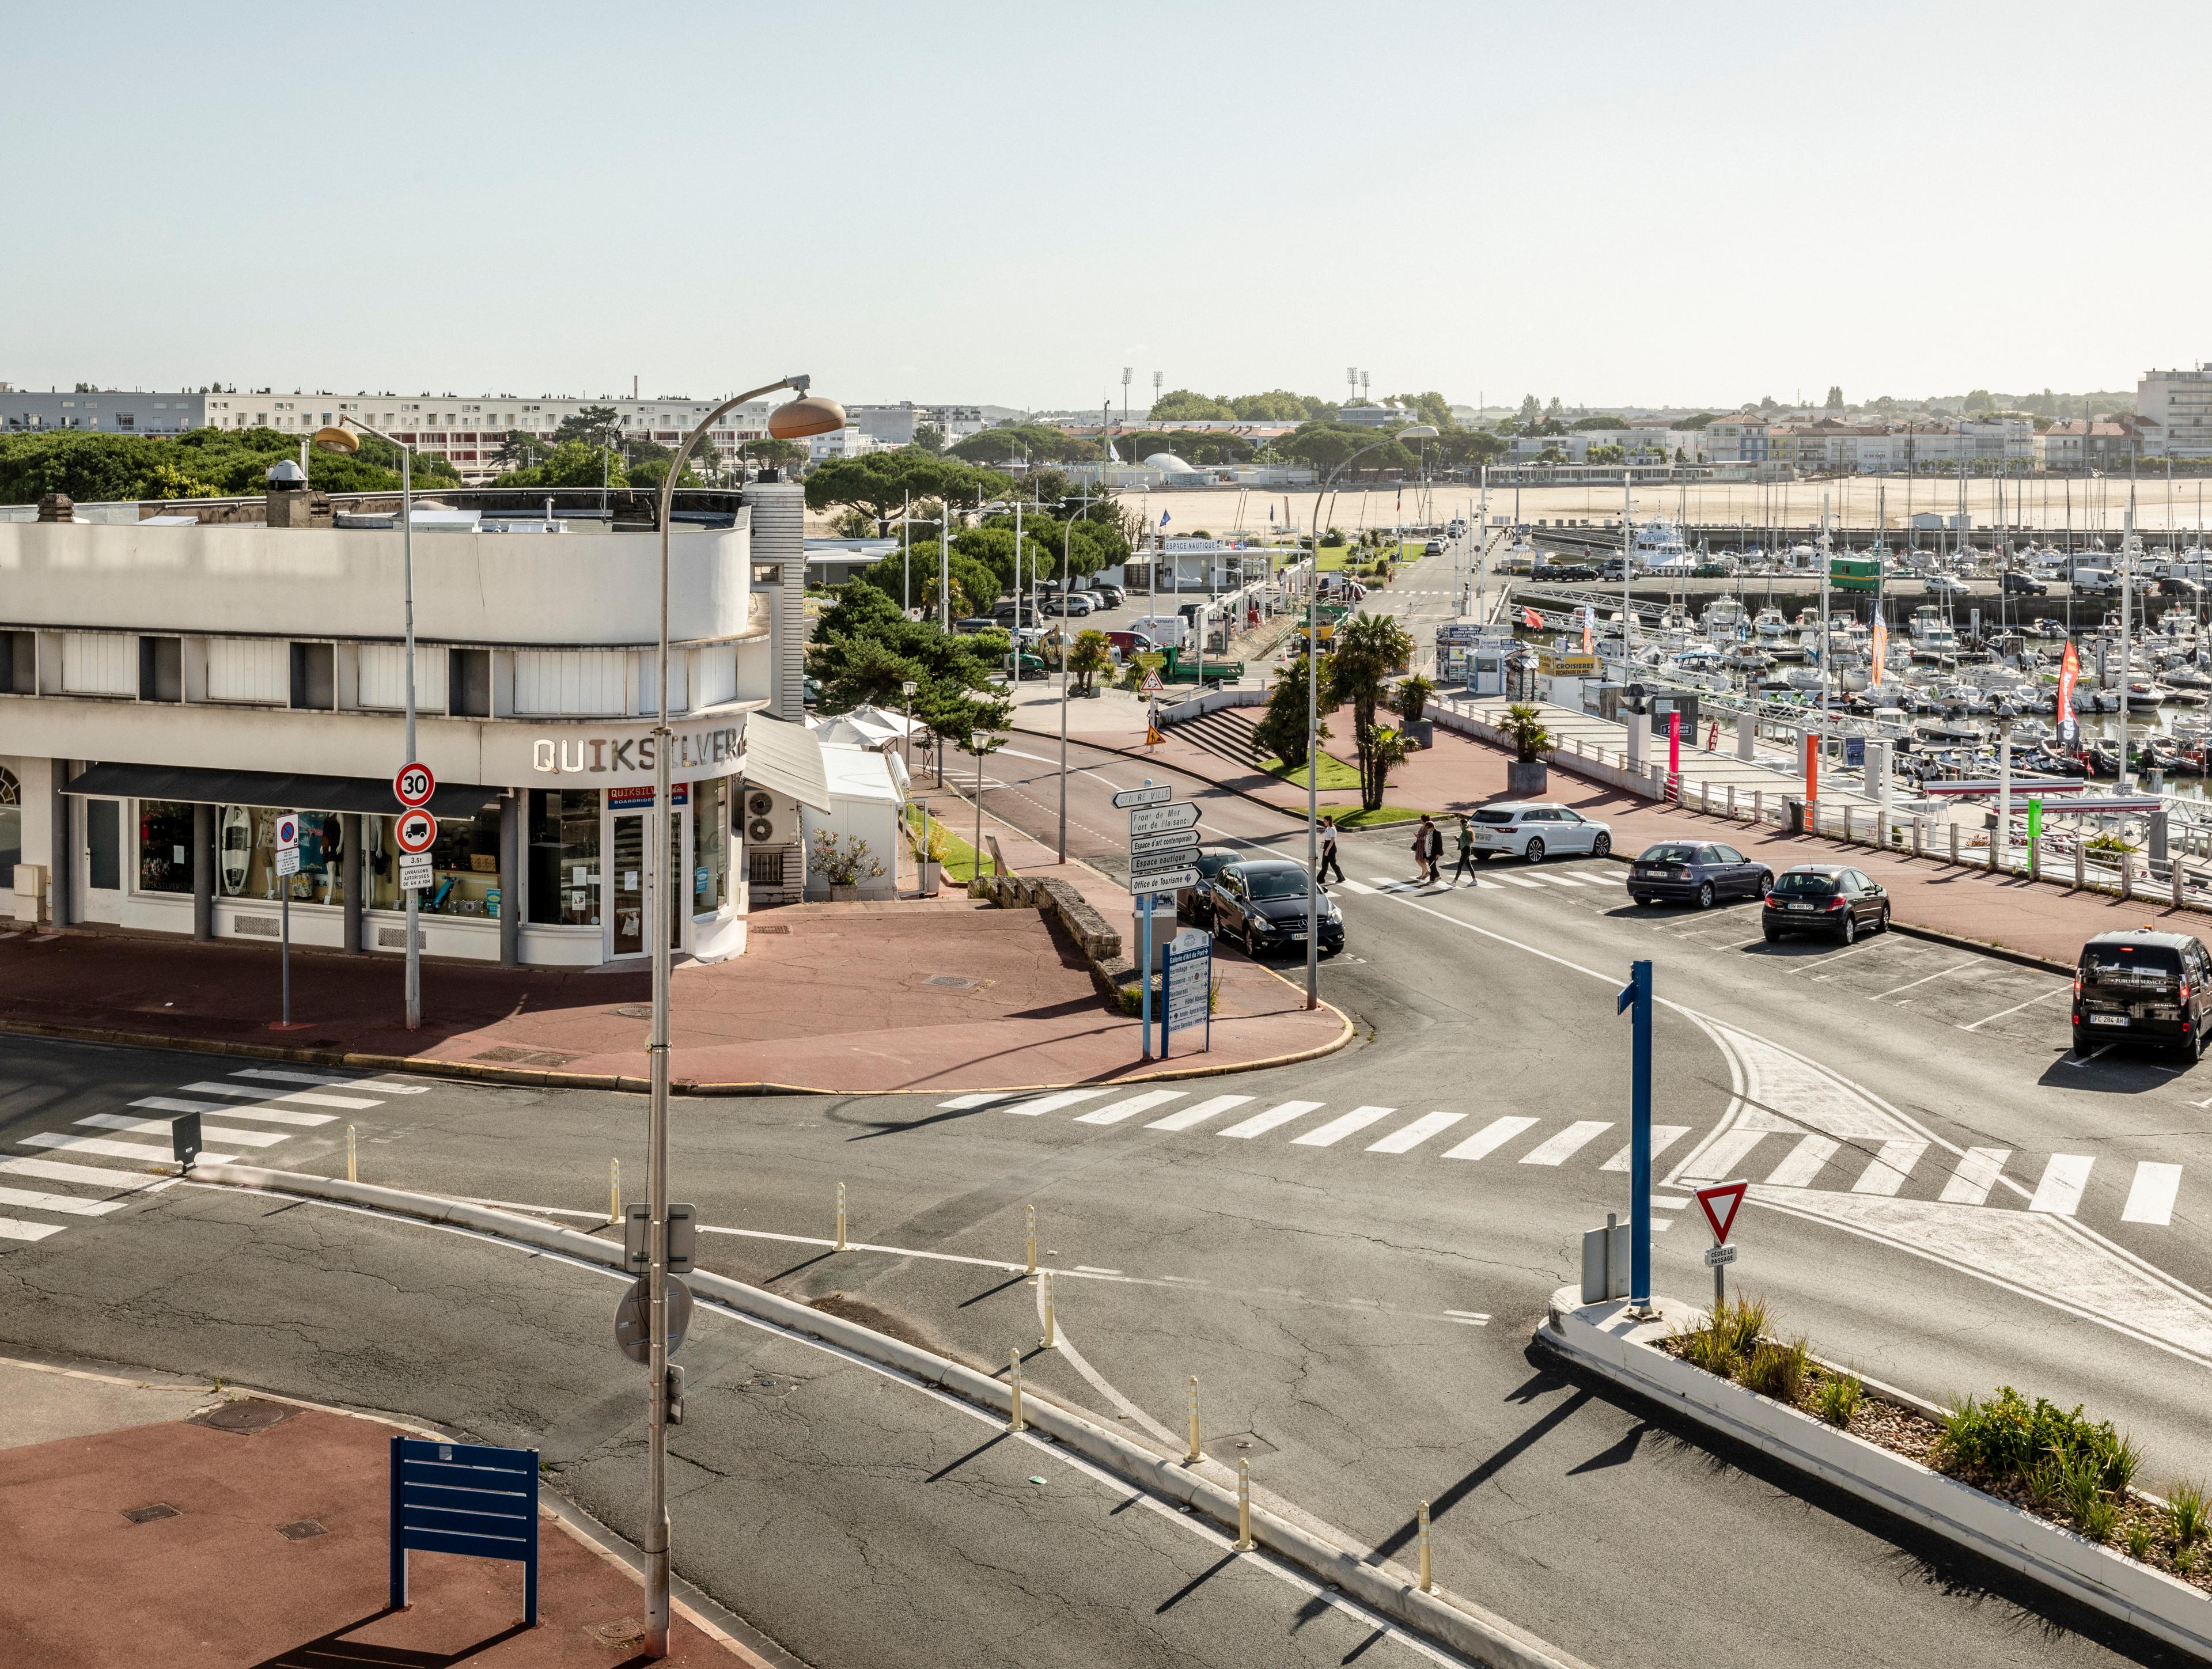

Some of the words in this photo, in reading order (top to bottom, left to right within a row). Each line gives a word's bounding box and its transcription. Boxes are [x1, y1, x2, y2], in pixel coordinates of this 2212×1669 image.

[1189, 541, 1215, 549] NAUTIQUE
[1710, 723, 1718, 749] TABA
[533, 728, 737, 774] QUIKSLVER
[403, 775, 427, 794] 30
[611, 787, 655, 798] QUIKSILV
[1151, 790, 1169, 800] VILLE
[1133, 814, 1151, 822] Front
[1156, 811, 1163, 819] de
[1133, 824, 1147, 832] Port
[1134, 842, 1150, 851] Espace
[1152, 839, 1162, 847] d'art
[1164, 834, 1192, 845] contemporain
[1136, 858, 1157, 868] Espace
[1160, 854, 1185, 866] nautique
[1134, 880, 1150, 889] Office
[1160, 876, 1183, 885] Tourisme
[1169, 954, 1183, 964] Galerie
[1183, 953, 1192, 961] d'Art
[1169, 966, 1188, 974] Hermitage
[1169, 976, 1185, 986] Brasserie
[1169, 988, 1188, 997] Restaurant
[1194, 994, 1207, 1002] Abacus
[1168, 1023, 1180, 1032] Seudre
[1180, 1021, 1192, 1029] Service
[1711, 1255, 1733, 1265] PASSAGE
